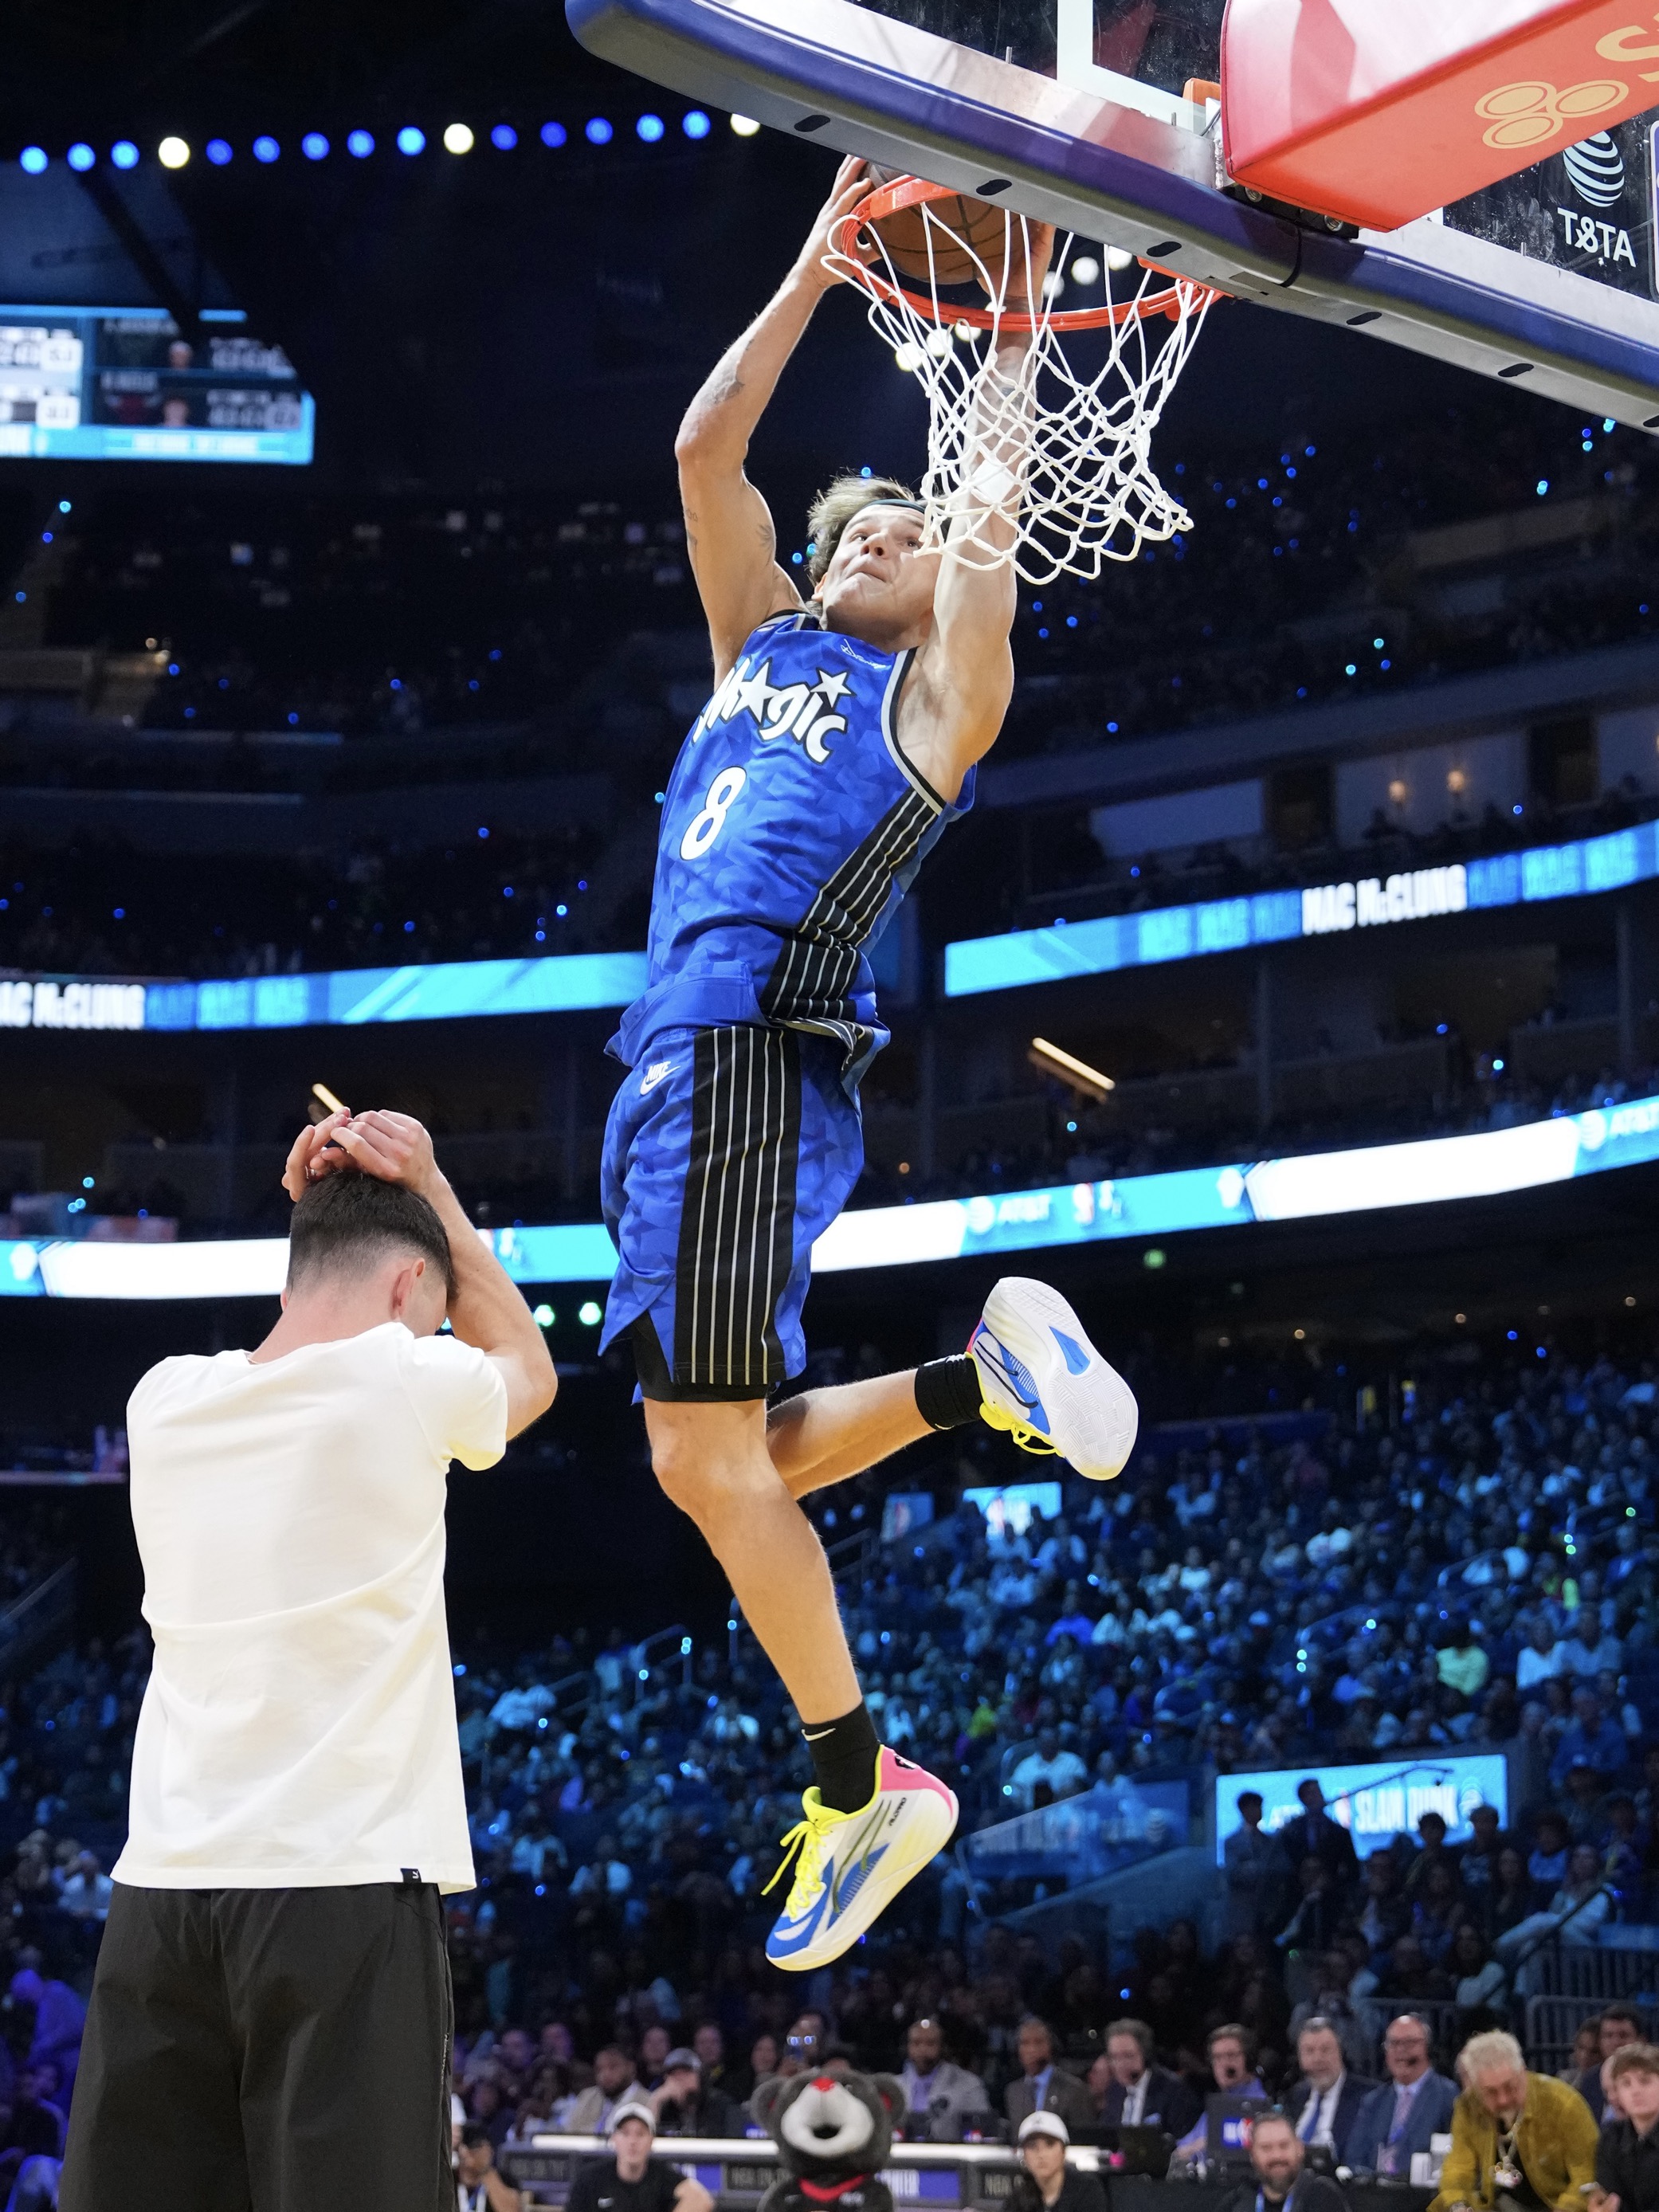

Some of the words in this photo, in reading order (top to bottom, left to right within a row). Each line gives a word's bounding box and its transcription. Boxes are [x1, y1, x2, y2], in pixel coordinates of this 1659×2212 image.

[680, 766, 747, 861] 8
[1302, 882, 1355, 935] MAC
[0, 981, 33, 1028] AC
[645, 1061, 672, 1083] NIKE
